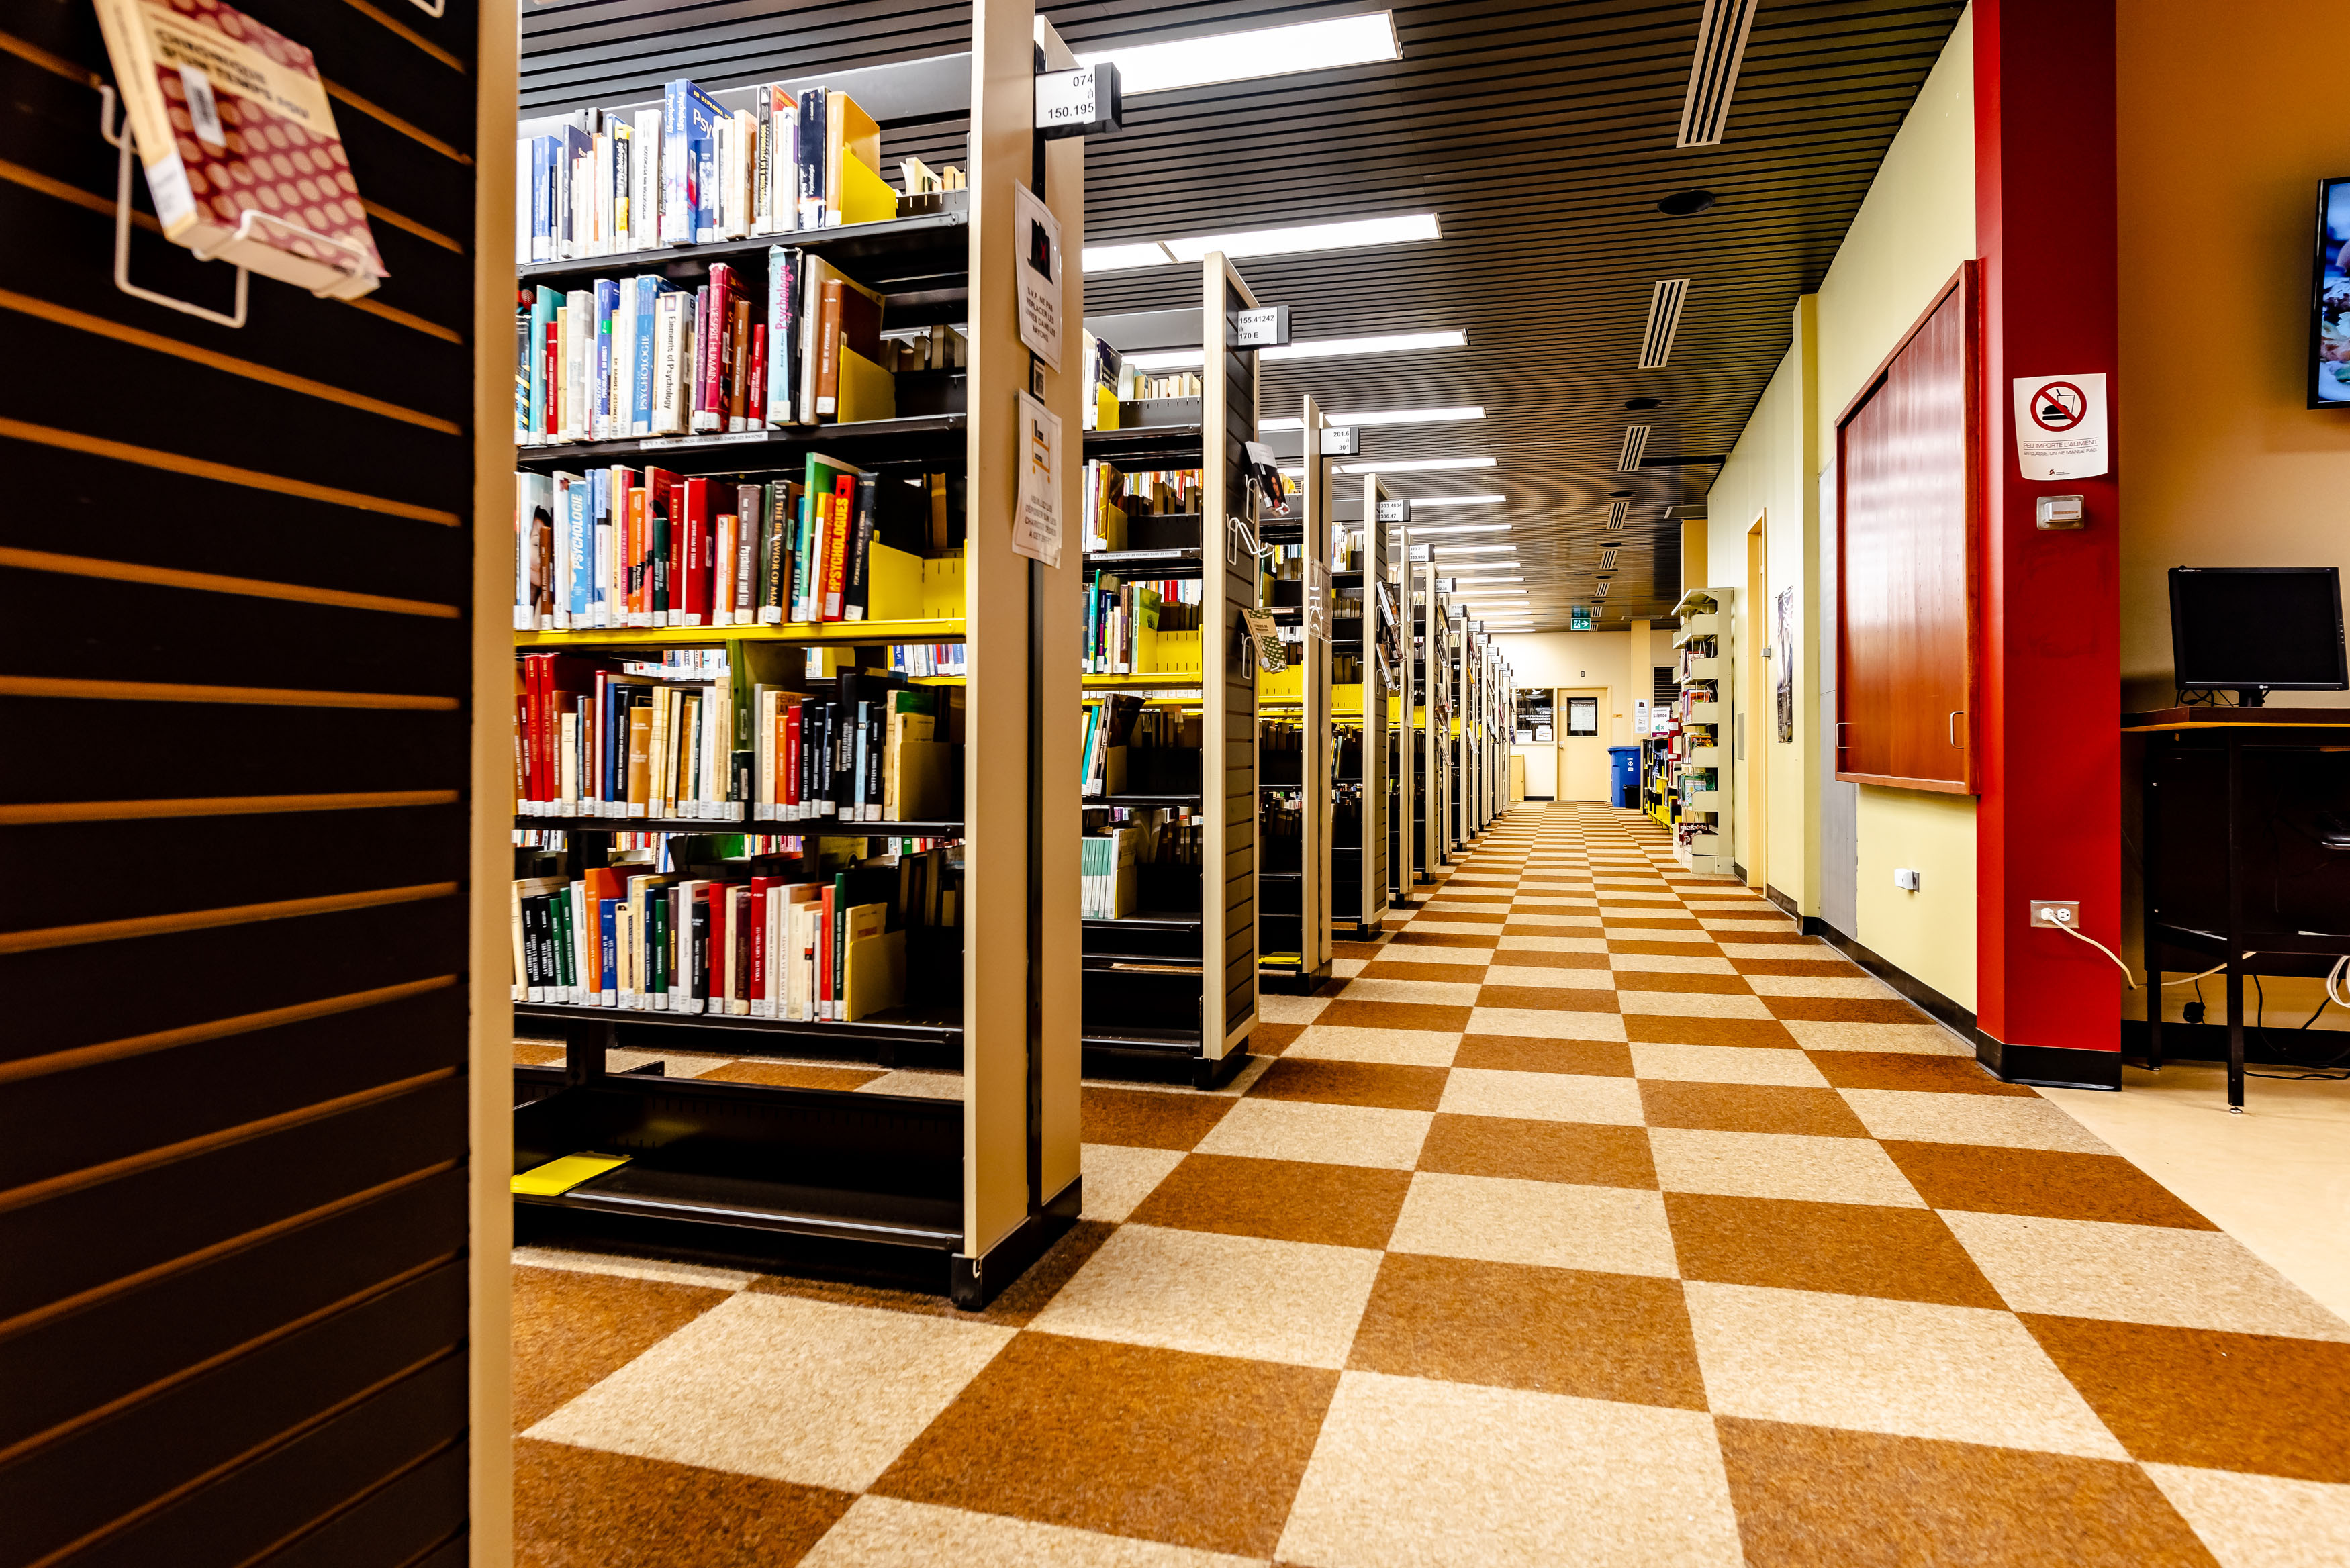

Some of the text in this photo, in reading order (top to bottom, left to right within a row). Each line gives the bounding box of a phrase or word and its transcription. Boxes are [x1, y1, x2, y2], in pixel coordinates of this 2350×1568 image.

[1073, 73, 1093, 87] 074
[1087, 88, 1093, 99] à
[666, 93, 675, 134] Psychology
[677, 91, 686, 131] Psychology
[701, 95, 723, 116] DIPLOMA
[1048, 103, 1094, 119] 150.195
[616, 141, 626, 184] Psychologie
[775, 264, 794, 330] Psychologie
[1239, 315, 1274, 324] 155.41242
[639, 334, 649, 410] PSYCHOLOGIE
[664, 316, 676, 409] Elements of Psychology
[708, 342, 718, 383] HUMAIN
[2064, 439, 2098, 447] L'ALIMENT
[775, 501, 784, 520] THE
[571, 493, 584, 570] PSYCHOLOGIE
[772, 523, 782, 570] BEHAVIOR
[830, 498, 849, 585] PSYCHOLOGUES
[738, 546, 751, 606] Psychology and Life
[769, 586, 778, 606] MAN
[771, 571, 779, 585] OF
